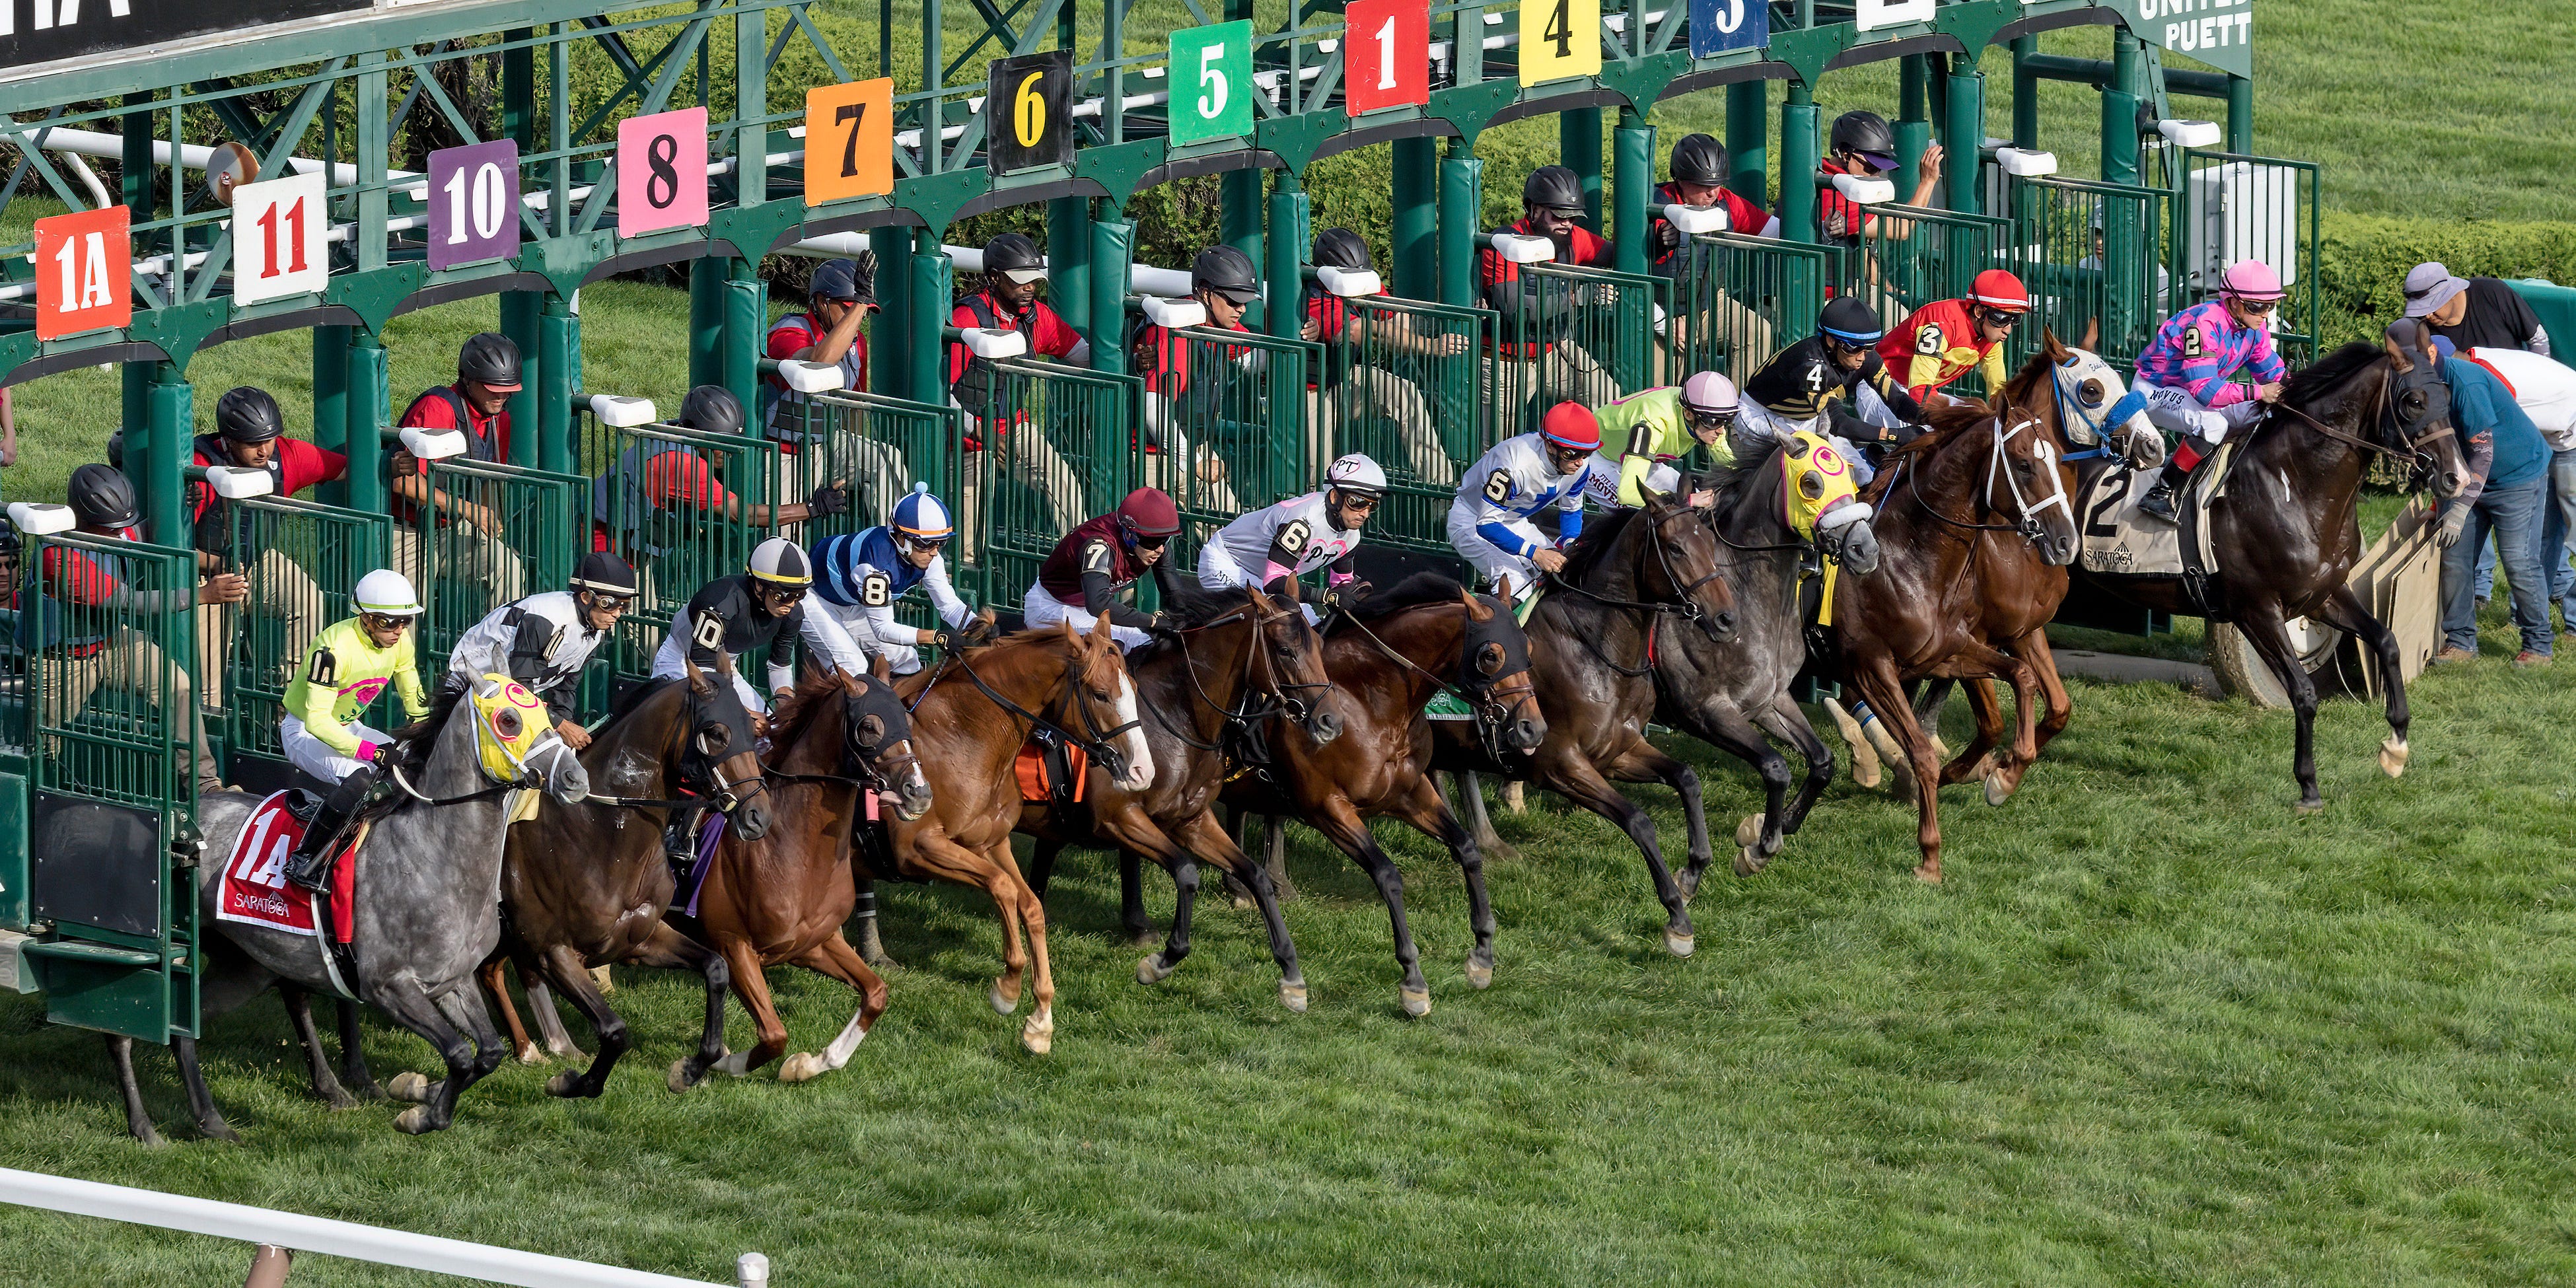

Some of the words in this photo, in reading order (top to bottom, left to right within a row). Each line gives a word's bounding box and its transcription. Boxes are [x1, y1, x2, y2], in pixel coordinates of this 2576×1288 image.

[1544, 0, 1573, 58] 4
[2166, 12, 2251, 51] PUETT
[1375, 15, 1397, 90] 1
[1198, 42, 1229, 119] 5
[1014, 71, 1046, 147] 6
[835, 102, 867, 178] 7
[647, 134, 678, 209] 8
[444, 162, 506, 248] 10
[257, 196, 307, 279] 11
[55, 231, 113, 313] 1A
[1918, 328, 1941, 353] 3
[2185, 328, 2201, 355] 2
[1807, 364, 1822, 391] 4
[1334, 458, 1359, 473] PT
[1486, 471, 1509, 501] 5
[2085, 464, 2131, 537] 2
[1281, 522, 1310, 551] 6
[1087, 544, 1107, 569] 7
[1305, 545, 1338, 567] PT
[2085, 550, 2133, 565] SARATOGA
[865, 577, 886, 605] 8
[692, 612, 722, 649] 10
[234, 807, 291, 890] 1A
[234, 892, 290, 918] SARATOGA
